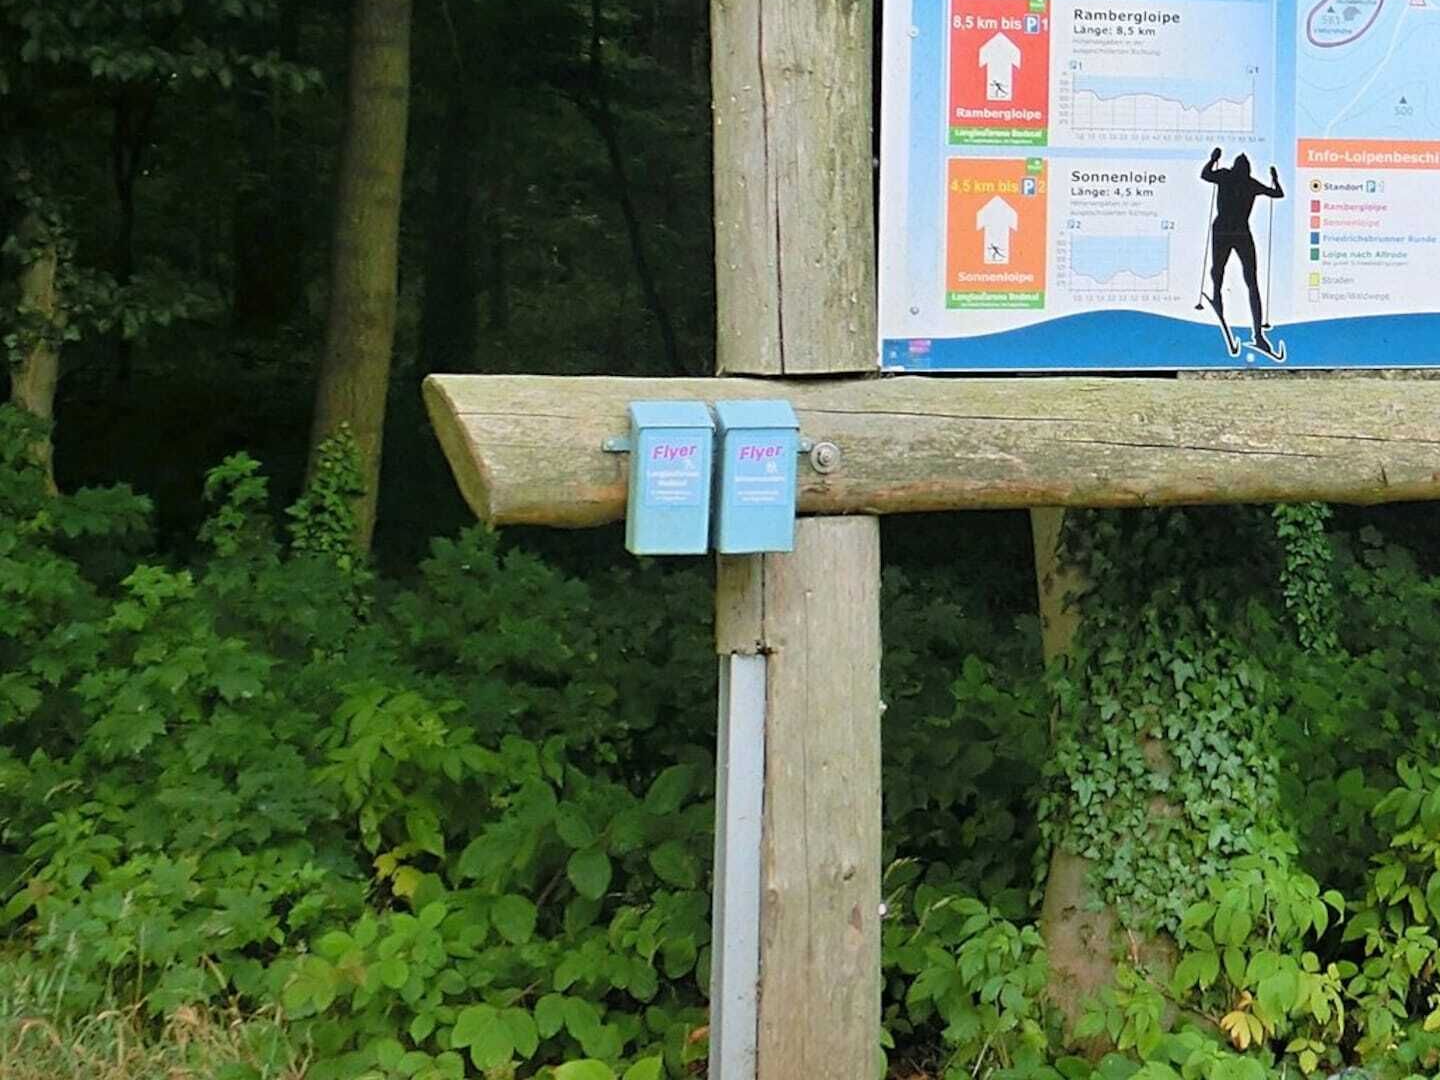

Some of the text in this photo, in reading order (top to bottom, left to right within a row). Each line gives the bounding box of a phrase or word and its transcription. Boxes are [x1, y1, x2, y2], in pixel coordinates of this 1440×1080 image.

[952, 16, 974, 31] 8,5
[976, 16, 998, 30] km
[1001, 17, 1022, 31] bis
[1042, 18, 1048, 31] 1
[1073, 9, 1181, 25] Rambergloipe
[1116, 26, 1135, 37] 8,5
[1138, 26, 1156, 37] km
[956, 107, 1042, 121] Rambergloipe
[1071, 170, 1167, 185] Sonnenloipe
[974, 180, 995, 192] km
[998, 180, 1018, 192] bis
[1023, 179, 1035, 195] P
[1113, 188, 1132, 198] 4,5
[1135, 188, 1154, 197] km
[1323, 182, 1363, 191] Standort
[958, 272, 1035, 283] Sonnenloipe
[653, 443, 698, 461] Flyer
[739, 444, 783, 461] Flyer
